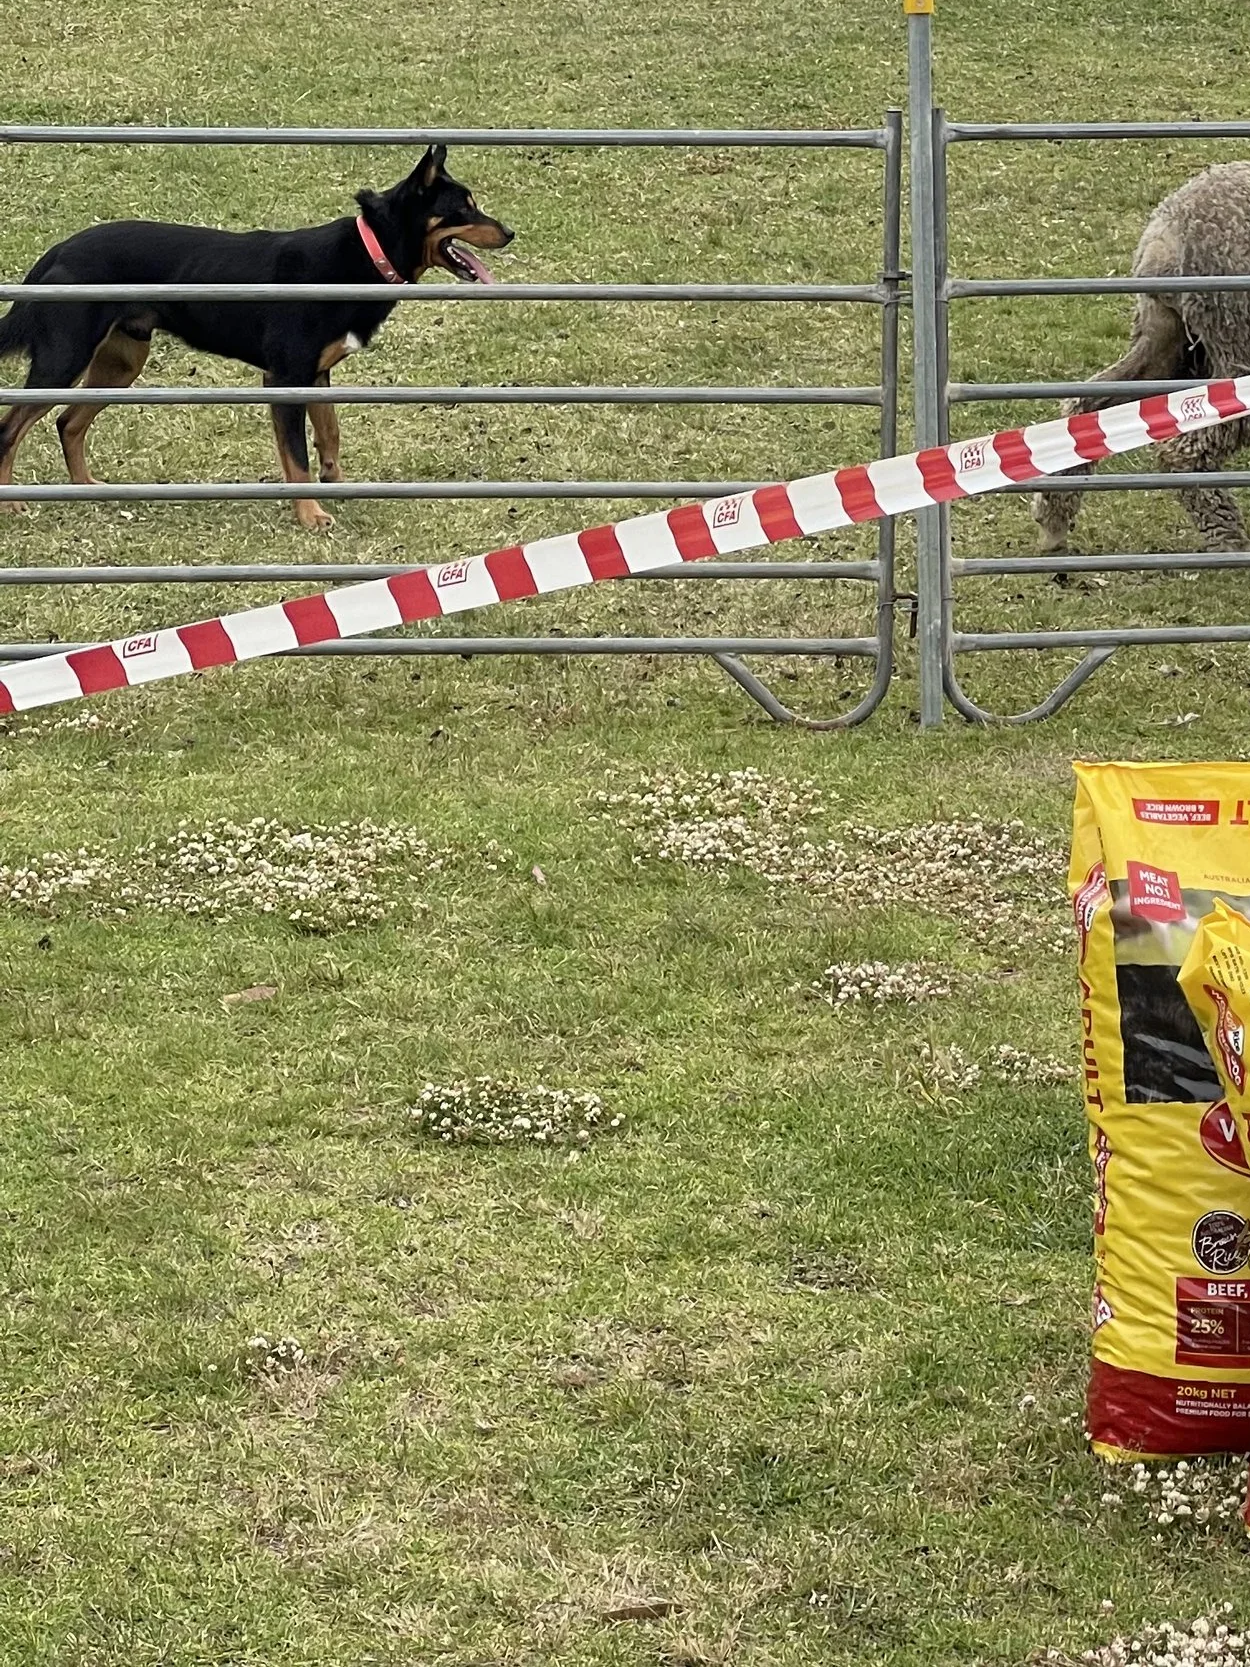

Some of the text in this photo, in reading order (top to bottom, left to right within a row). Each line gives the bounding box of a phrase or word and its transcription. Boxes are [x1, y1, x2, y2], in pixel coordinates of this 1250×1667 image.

[964, 455, 982, 471] CFA
[717, 509, 737, 525] CFA
[441, 567, 463, 583] CFA
[127, 637, 152, 653] CFA
[1138, 869, 1169, 888] MEAT
[1144, 883, 1170, 899] NO.1
[1133, 896, 1182, 912] INGREDIENT
[1207, 1282, 1249, 1299] BEEF,
[1190, 1307, 1225, 1316] PROTEIN
[1190, 1318, 1225, 1335] 25%
[1176, 1385, 1237, 1400] 20kg NET
